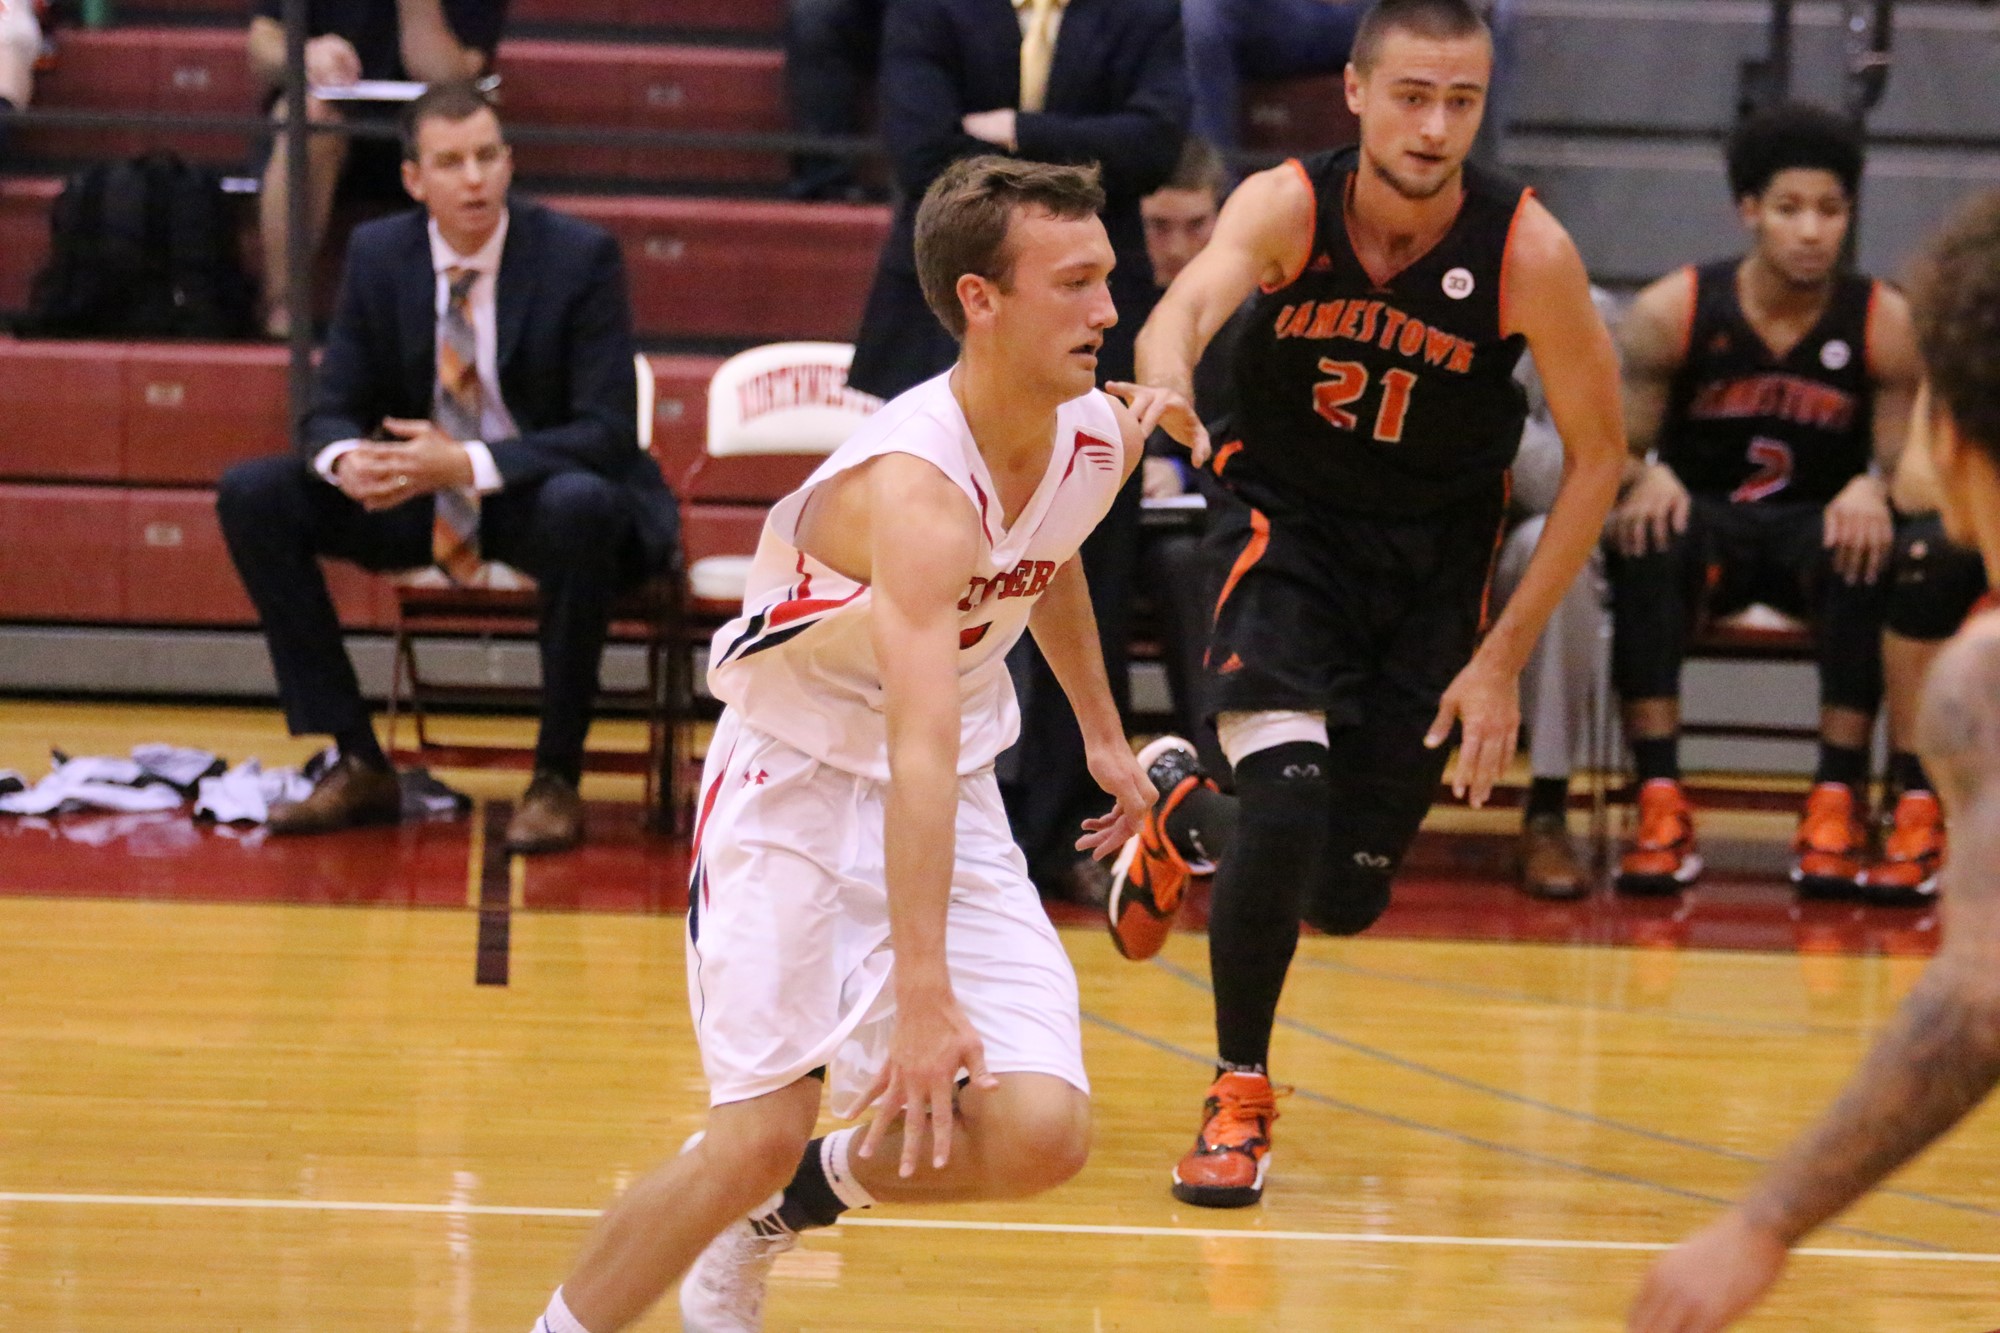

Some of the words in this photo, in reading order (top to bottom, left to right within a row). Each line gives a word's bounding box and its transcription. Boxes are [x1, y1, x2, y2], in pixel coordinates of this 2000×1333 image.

[1275, 299, 1475, 373] JAMESTOWN
[1313, 356, 1418, 442] 21
[1731, 437, 1794, 502] 2
